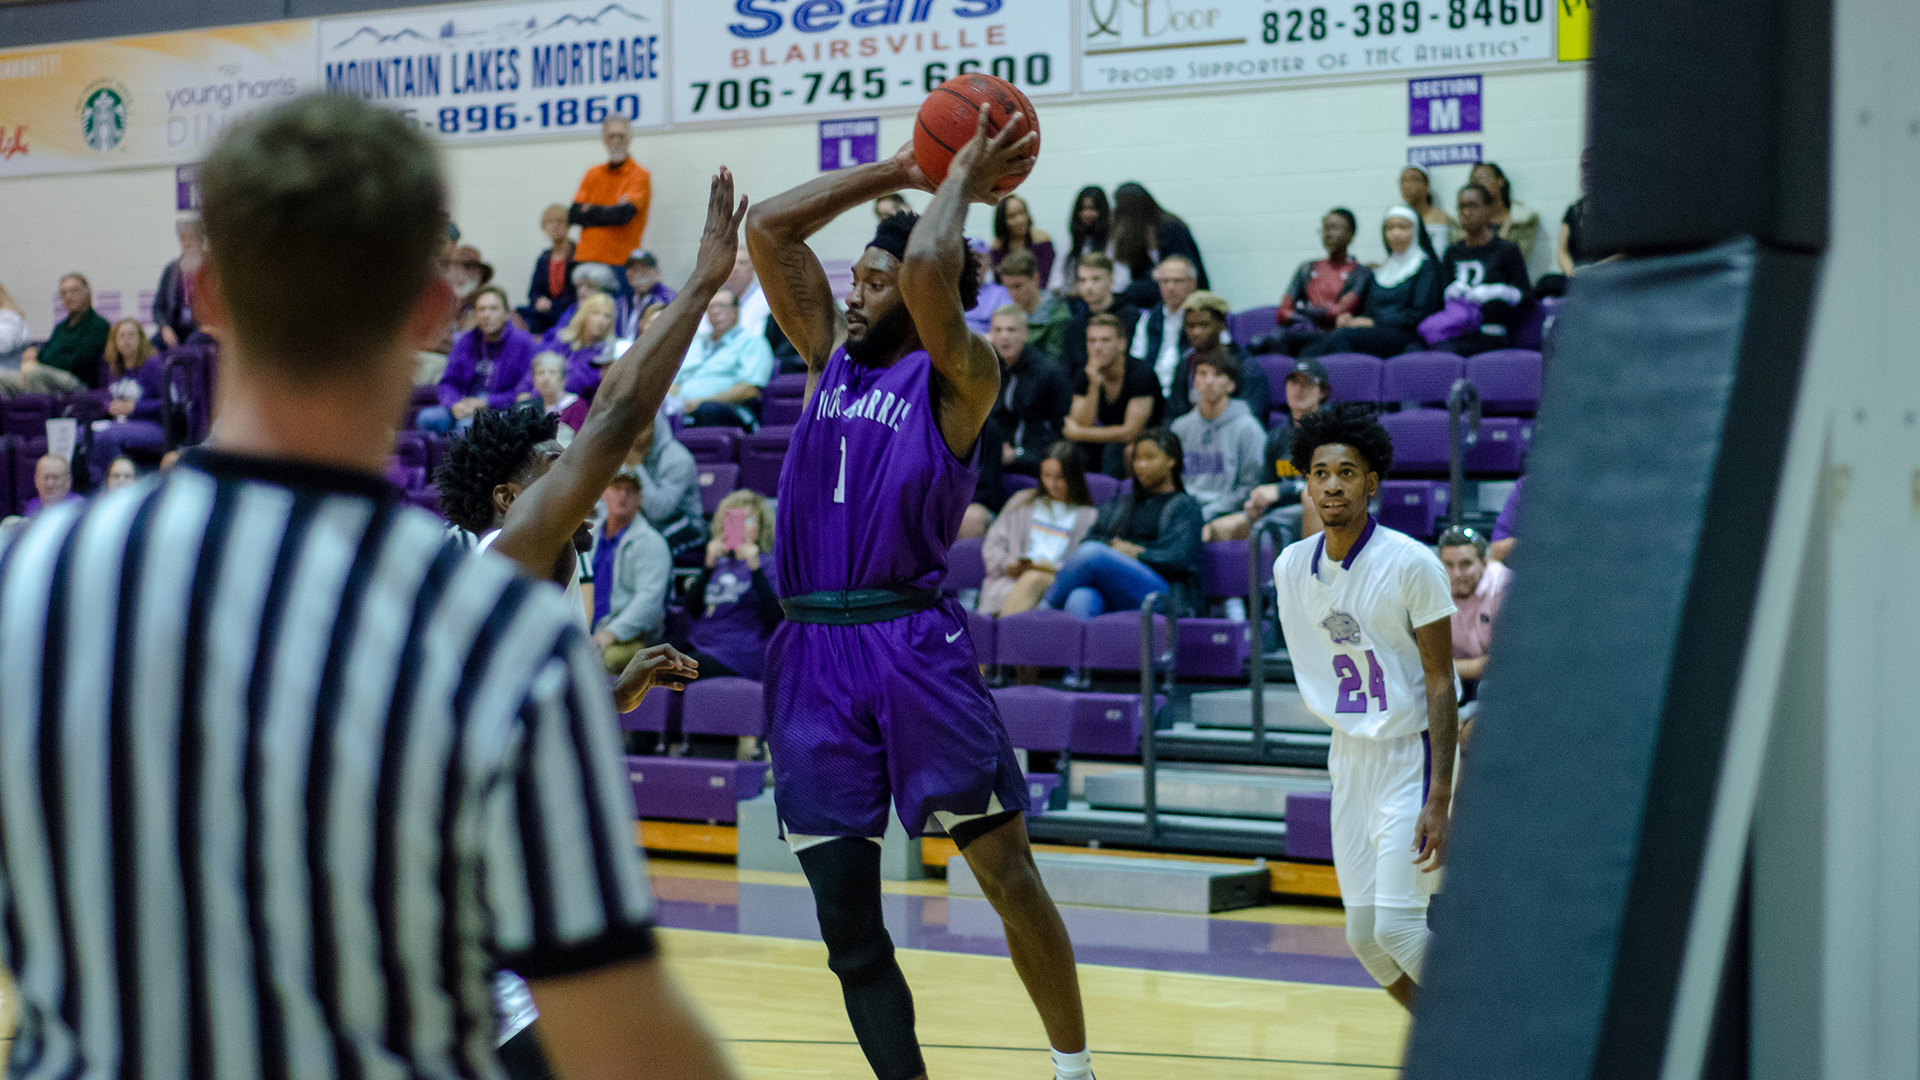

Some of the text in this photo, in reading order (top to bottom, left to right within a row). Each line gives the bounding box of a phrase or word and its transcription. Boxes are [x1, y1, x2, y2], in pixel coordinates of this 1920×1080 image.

[1263, 0, 1543, 44] 828-389-8460
[325, 35, 658, 98] MOUNTAIN LAKES MORTGAGE
[731, 25, 1006, 69] BLAIRSVILLE
[166, 83, 232, 113] young
[1411, 78, 1479, 99] SECTION
[1429, 98, 1461, 132] M
[841, 138, 858, 167] L
[1410, 146, 1480, 165] GENERAL
[833, 435, 847, 504] 1
[1332, 649, 1388, 714] 24
